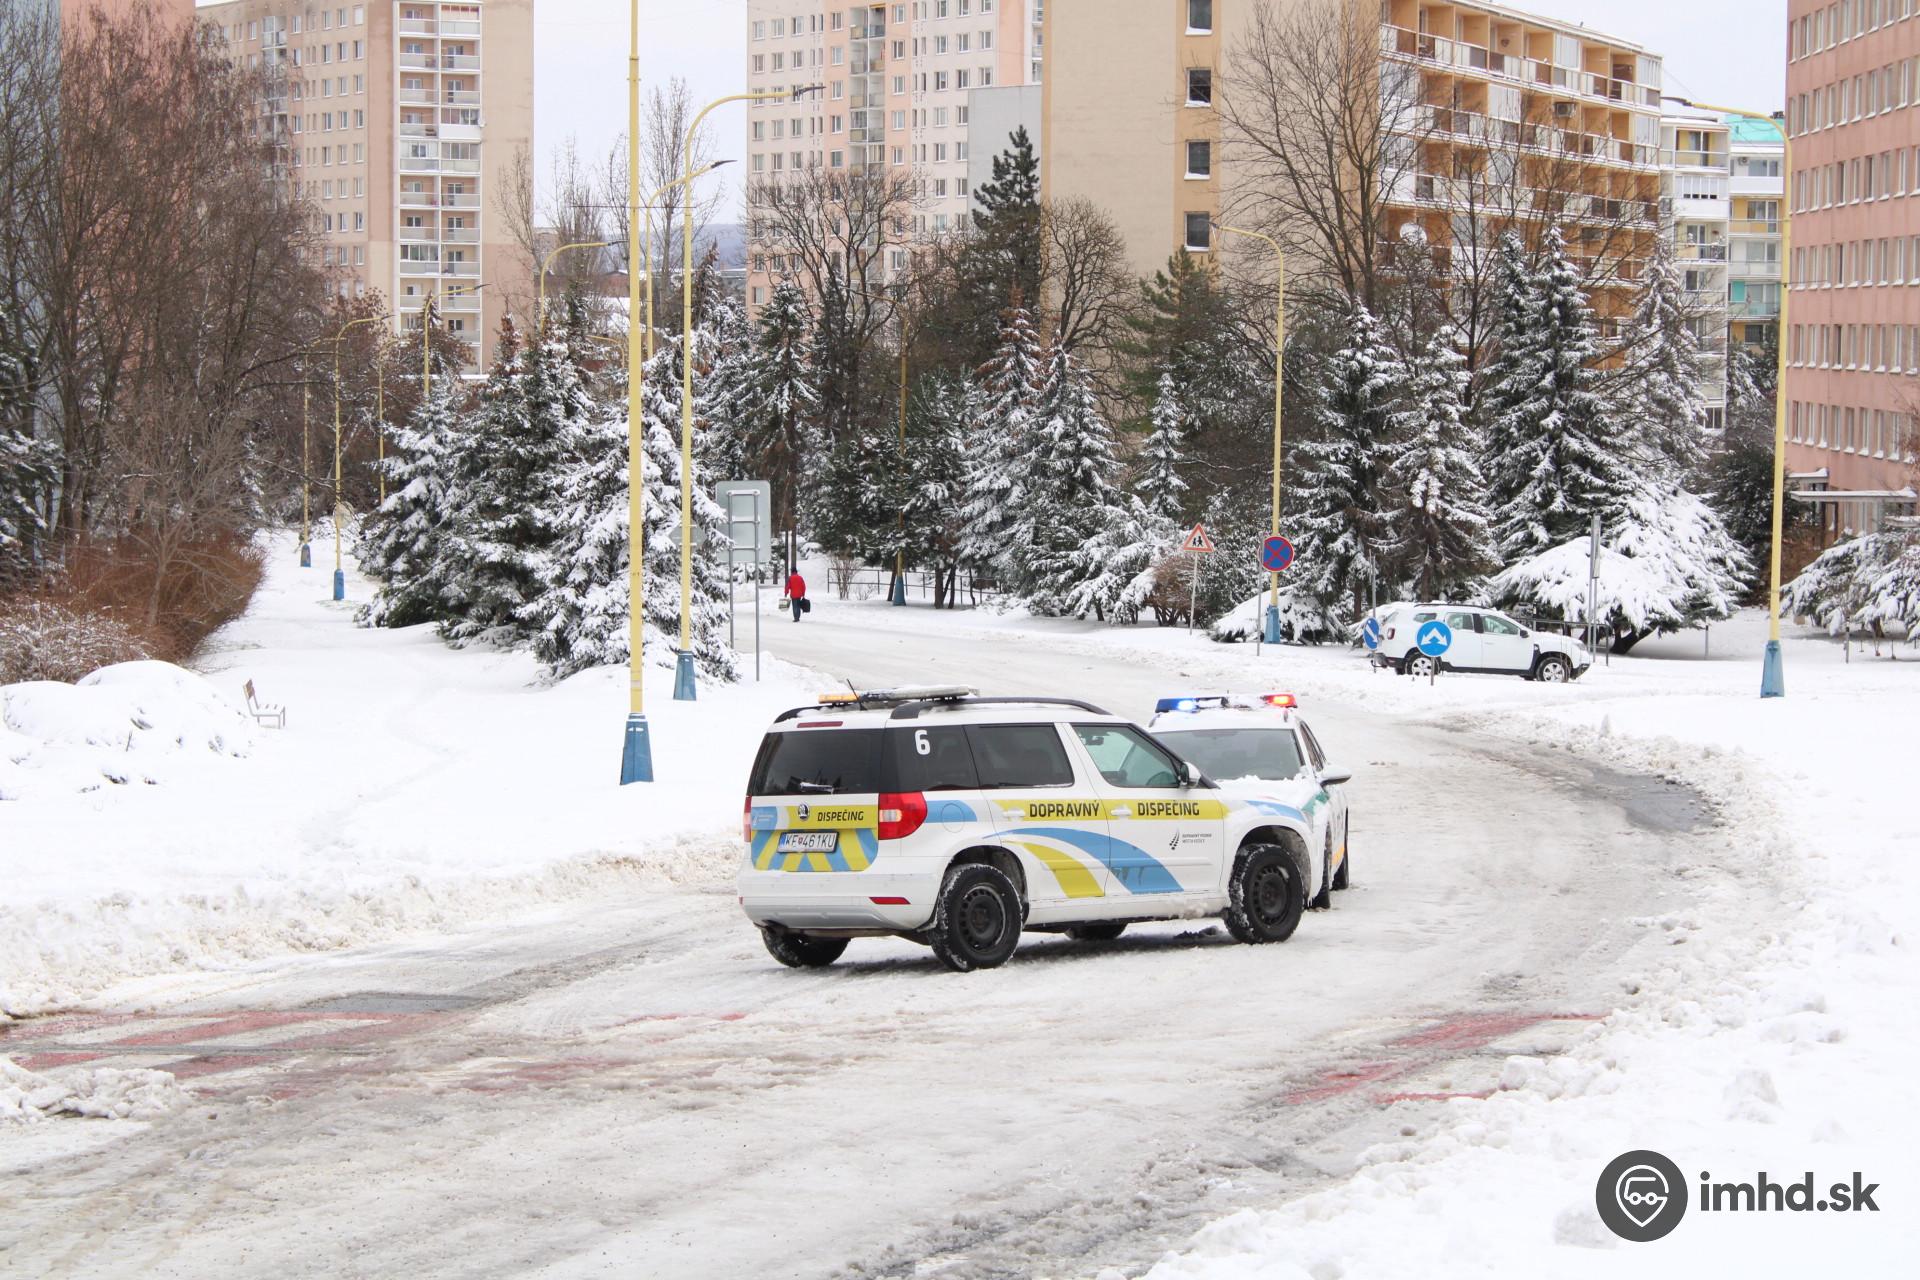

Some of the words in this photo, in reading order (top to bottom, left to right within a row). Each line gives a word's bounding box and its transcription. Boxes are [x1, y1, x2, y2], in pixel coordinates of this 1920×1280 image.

[915, 729, 930, 755] 6
[817, 809, 864, 822] DISPEČING
[1029, 799, 1100, 817] DOPRAVNÝ
[1137, 799, 1200, 816] DISPEČING
